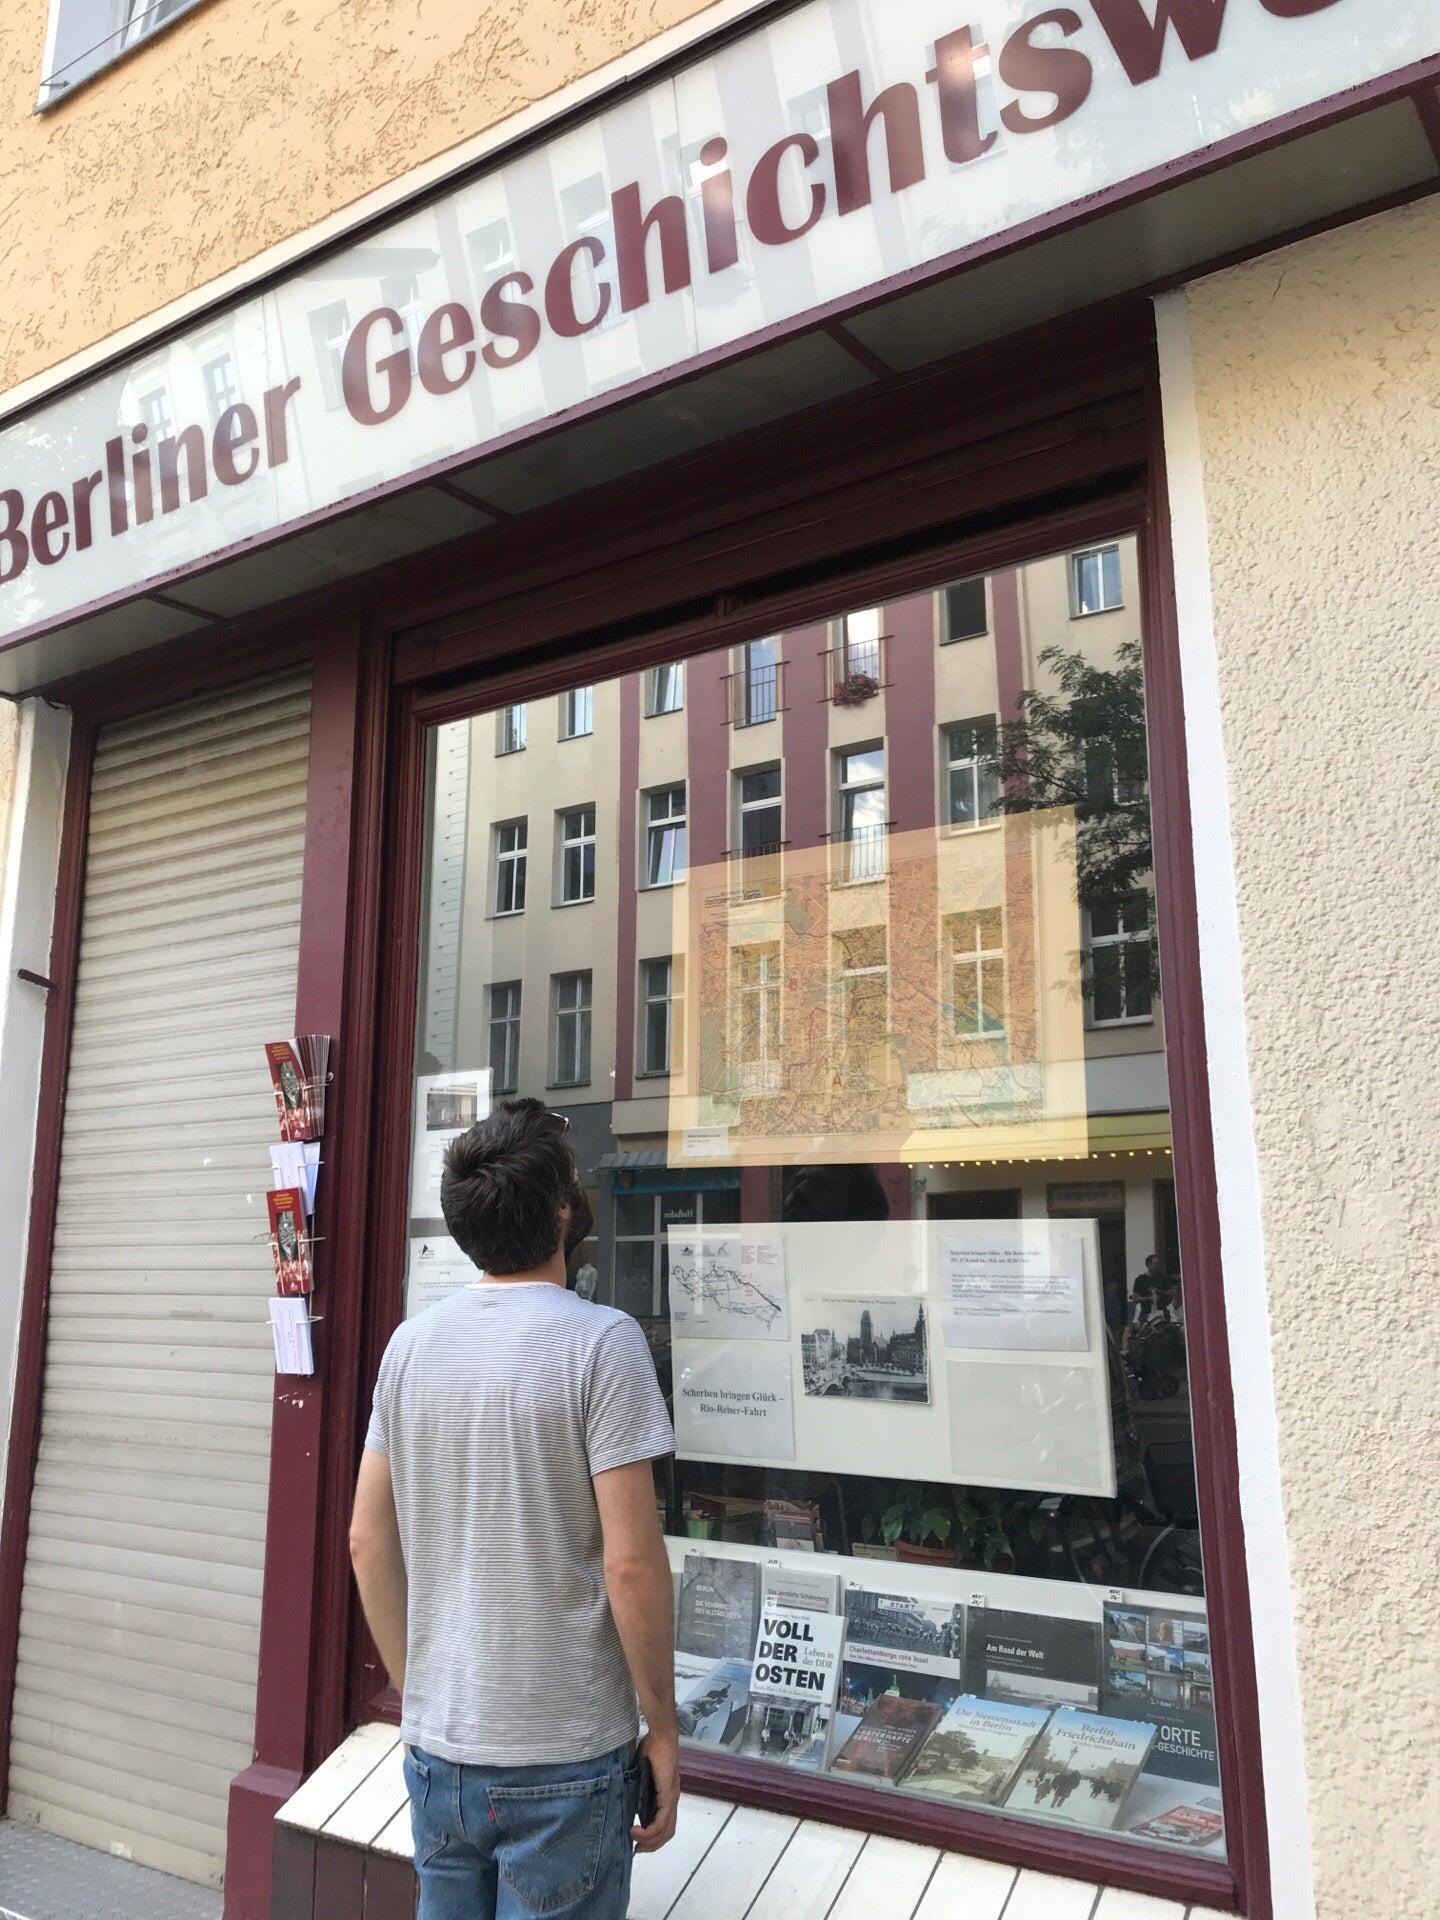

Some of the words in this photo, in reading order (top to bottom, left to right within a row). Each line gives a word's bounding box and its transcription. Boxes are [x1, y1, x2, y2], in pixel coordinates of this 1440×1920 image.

[342, 0, 1342, 426] Geschichtsw
[682, 1388, 718, 1398] Scherben
[720, 1390, 751, 1402] bringen
[752, 1391, 777, 1402] Glück
[700, 1403, 767, 1417] Rio-Reiser-Fahrt
[764, 1618, 814, 1642] VOLL
[758, 1641, 797, 1663] DER
[804, 1647, 826, 1658] Leben
[848, 1645, 897, 1660] Charlottenburgs
[899, 1652, 912, 1662] rote
[913, 1655, 929, 1665] Insel
[986, 1643, 998, 1652] Am
[999, 1645, 1015, 1655] Rand
[1016, 1648, 1027, 1656] der
[1028, 1649, 1044, 1660] Welt
[802, 1656, 813, 1666] der
[815, 1658, 833, 1669] DDR
[755, 1663, 825, 1691] OSTEN
[956, 1708, 973, 1716] Die
[975, 1711, 1037, 1729] Siemensstadt
[982, 1721, 1013, 1732] Berlin
[1056, 1728, 1137, 1751] Friedrichshain
[1160, 1725, 1201, 1747] ORTE
[1151, 1741, 1215, 1761] -GESCHICHTE
